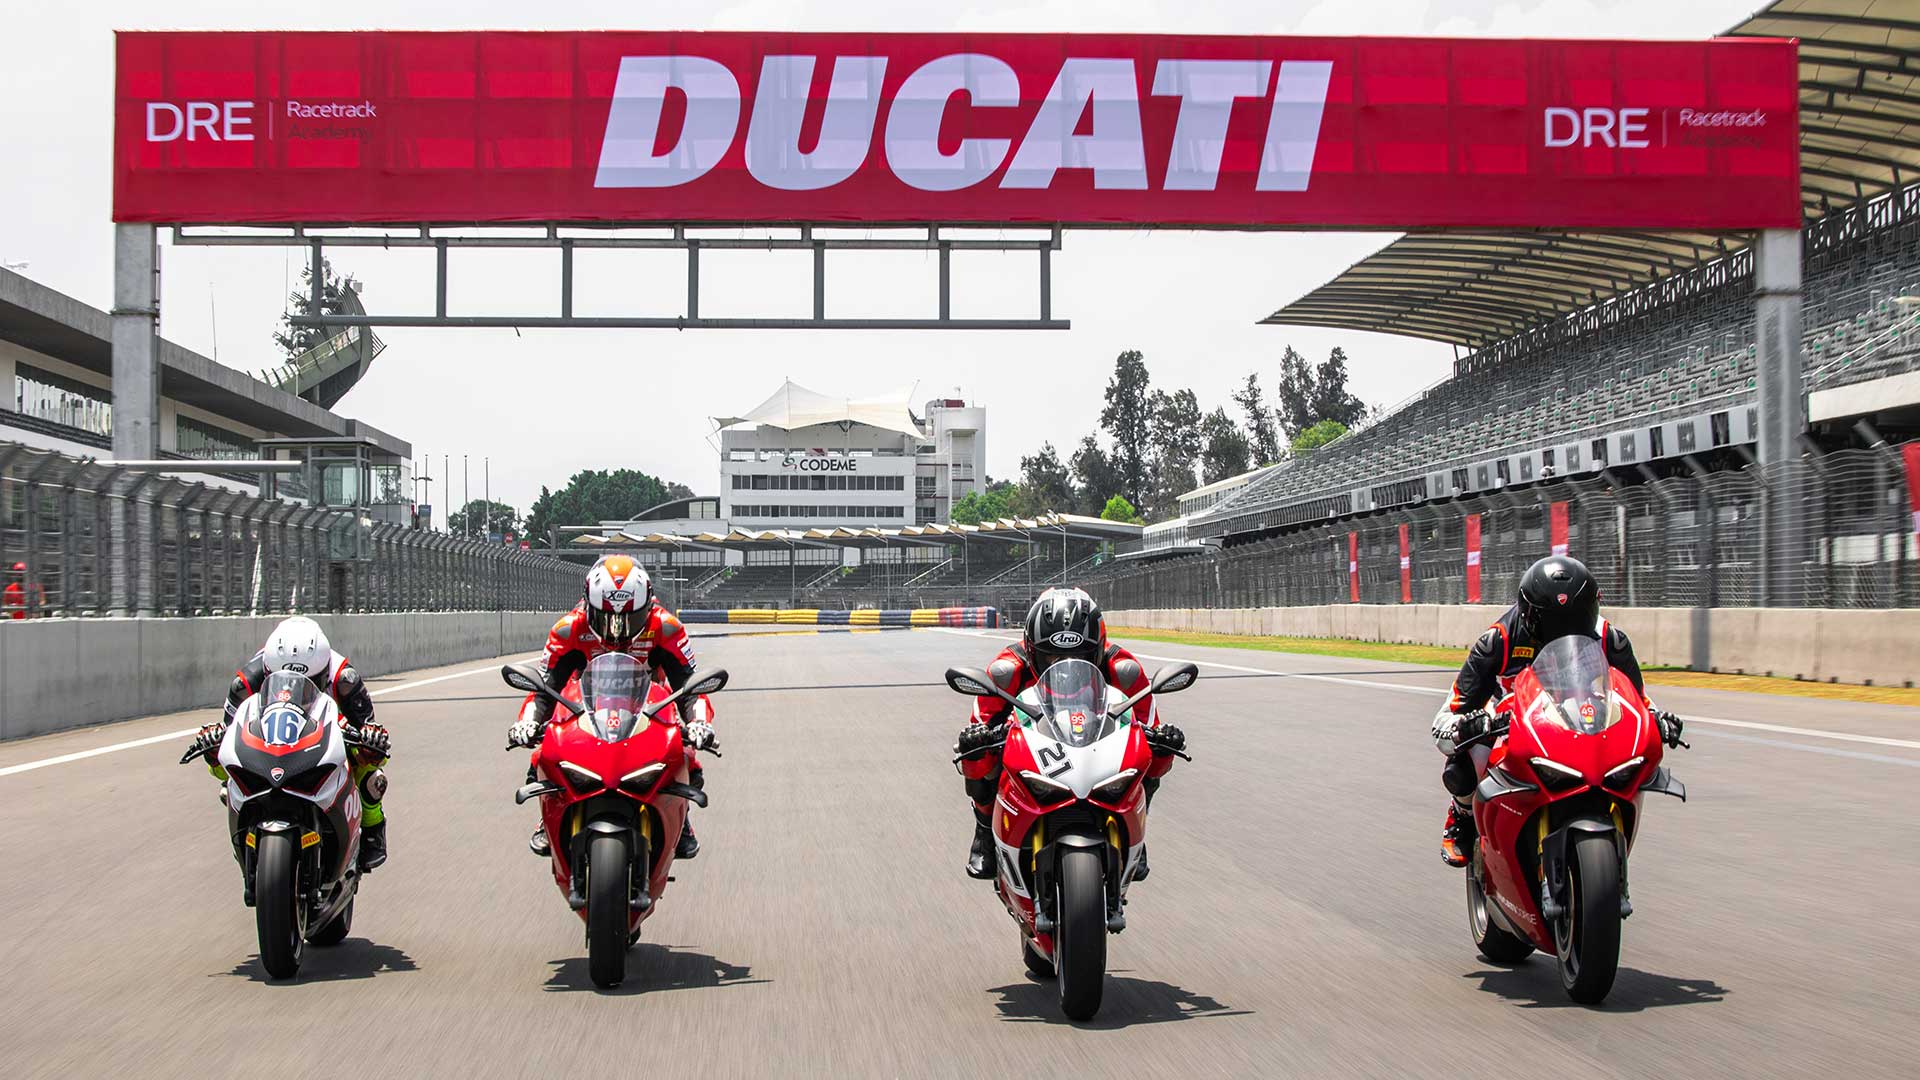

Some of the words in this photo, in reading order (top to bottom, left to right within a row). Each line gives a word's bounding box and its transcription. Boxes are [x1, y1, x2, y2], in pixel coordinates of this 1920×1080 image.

[287, 100, 377, 118] Racetrack
[1679, 108, 1767, 127] Racetrack
[146, 101, 255, 142] DRE
[593, 53, 1334, 191] DUCATI
[1544, 107, 1650, 148] DRE
[800, 459, 857, 471] CODEME
[1053, 634, 1079, 644] Arai
[1071, 715, 1085, 726] 99
[1581, 707, 1594, 718] 49
[264, 711, 299, 744] 16
[1037, 742, 1074, 779] 21
